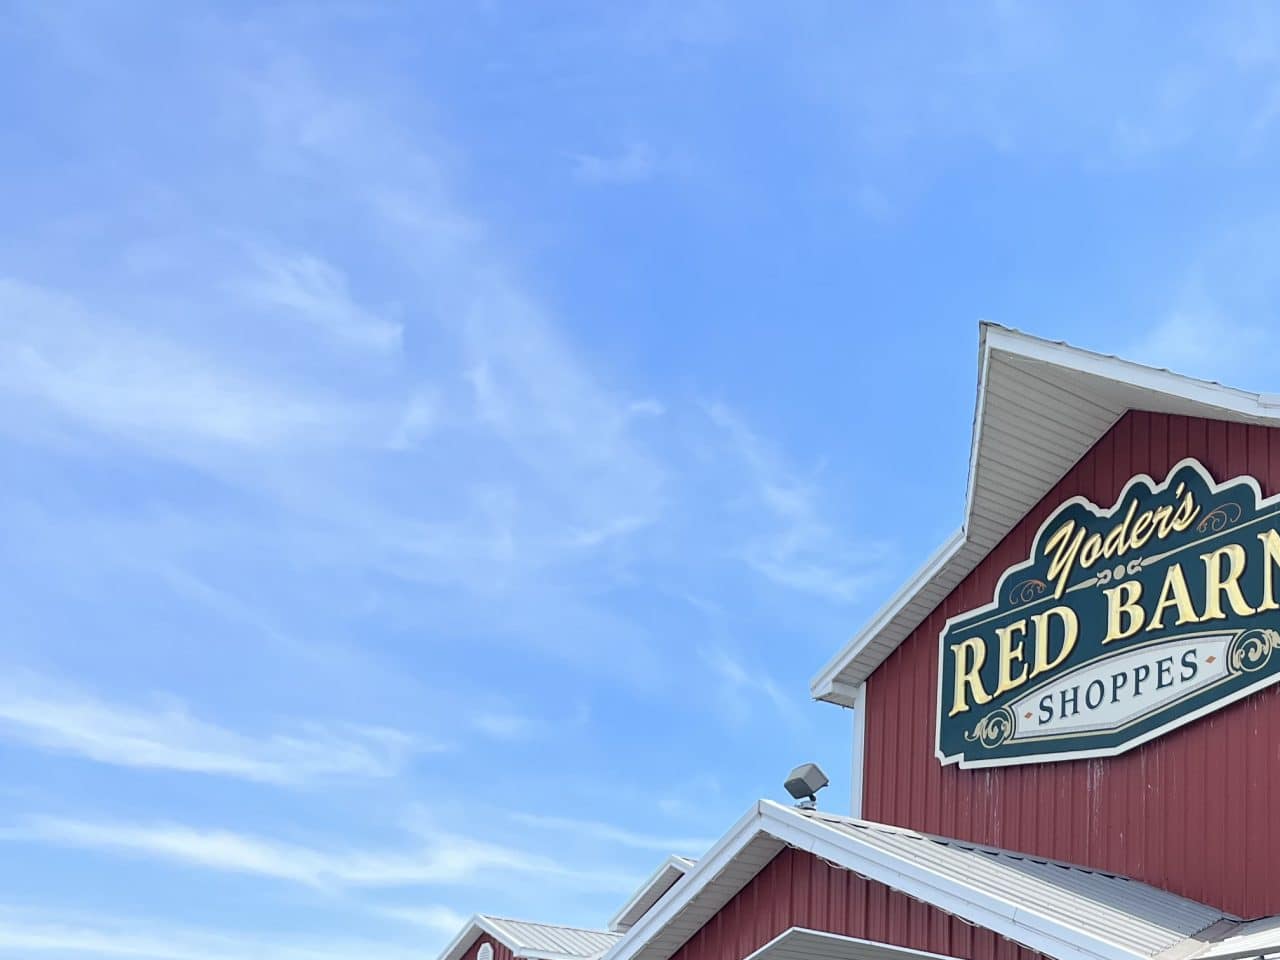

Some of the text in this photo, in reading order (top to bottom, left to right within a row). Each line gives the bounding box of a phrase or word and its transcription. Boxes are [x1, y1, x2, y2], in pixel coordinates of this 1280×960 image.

[1043, 481, 1202, 600] Yoder's
[948, 605, 1080, 718] RED
[1037, 648, 1200, 726] SHOPPES
